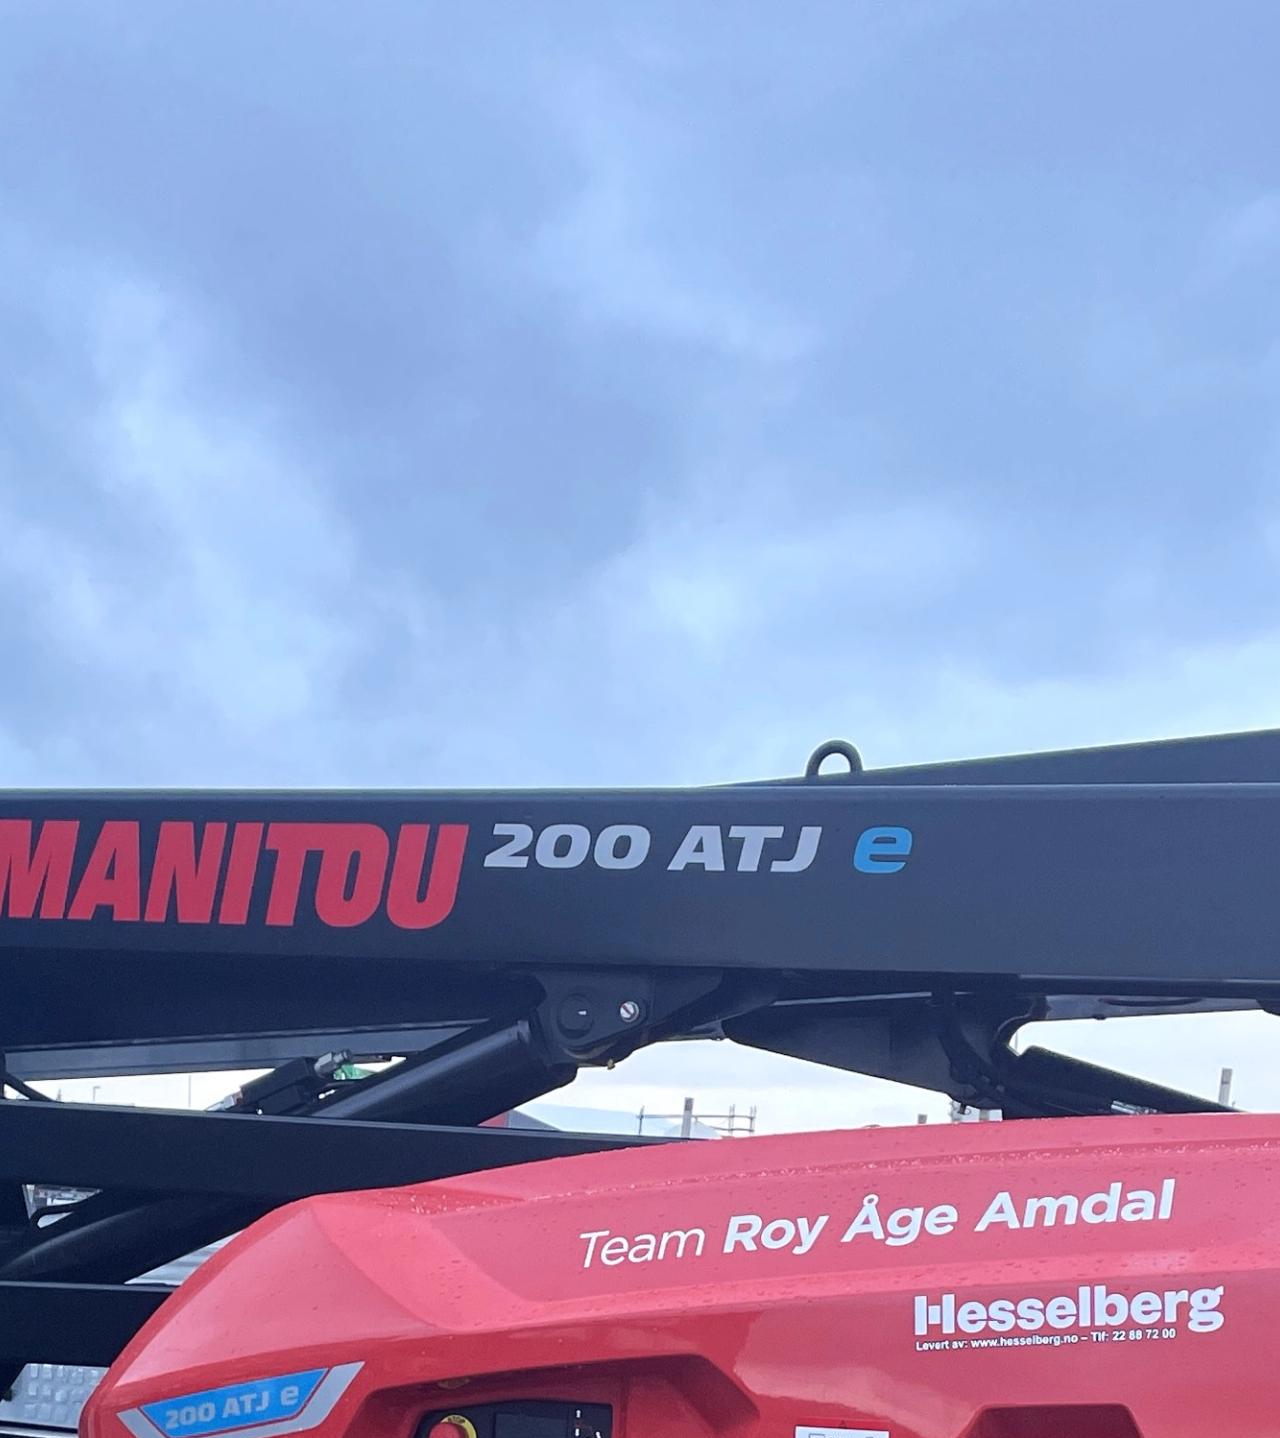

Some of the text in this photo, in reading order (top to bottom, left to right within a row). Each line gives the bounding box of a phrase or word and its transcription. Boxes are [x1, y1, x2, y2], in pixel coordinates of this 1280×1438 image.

[483, 822, 651, 870] 200
[666, 824, 823, 873] ATJ
[852, 826, 913, 873] e
[578, 1178, 1176, 1269] Team Roy Åge Amdal
[914, 1284, 1225, 1336] Hesselberg
[915, 1340, 950, 1351] Levert
[970, 1334, 1079, 1348] www.hesselberg.no
[1112, 1330, 1126, 1341] 22
[1145, 1329, 1159, 1339] 72
[1161, 1328, 1176, 1339] 00
[164, 1386, 300, 1430] 200 ATJ e
